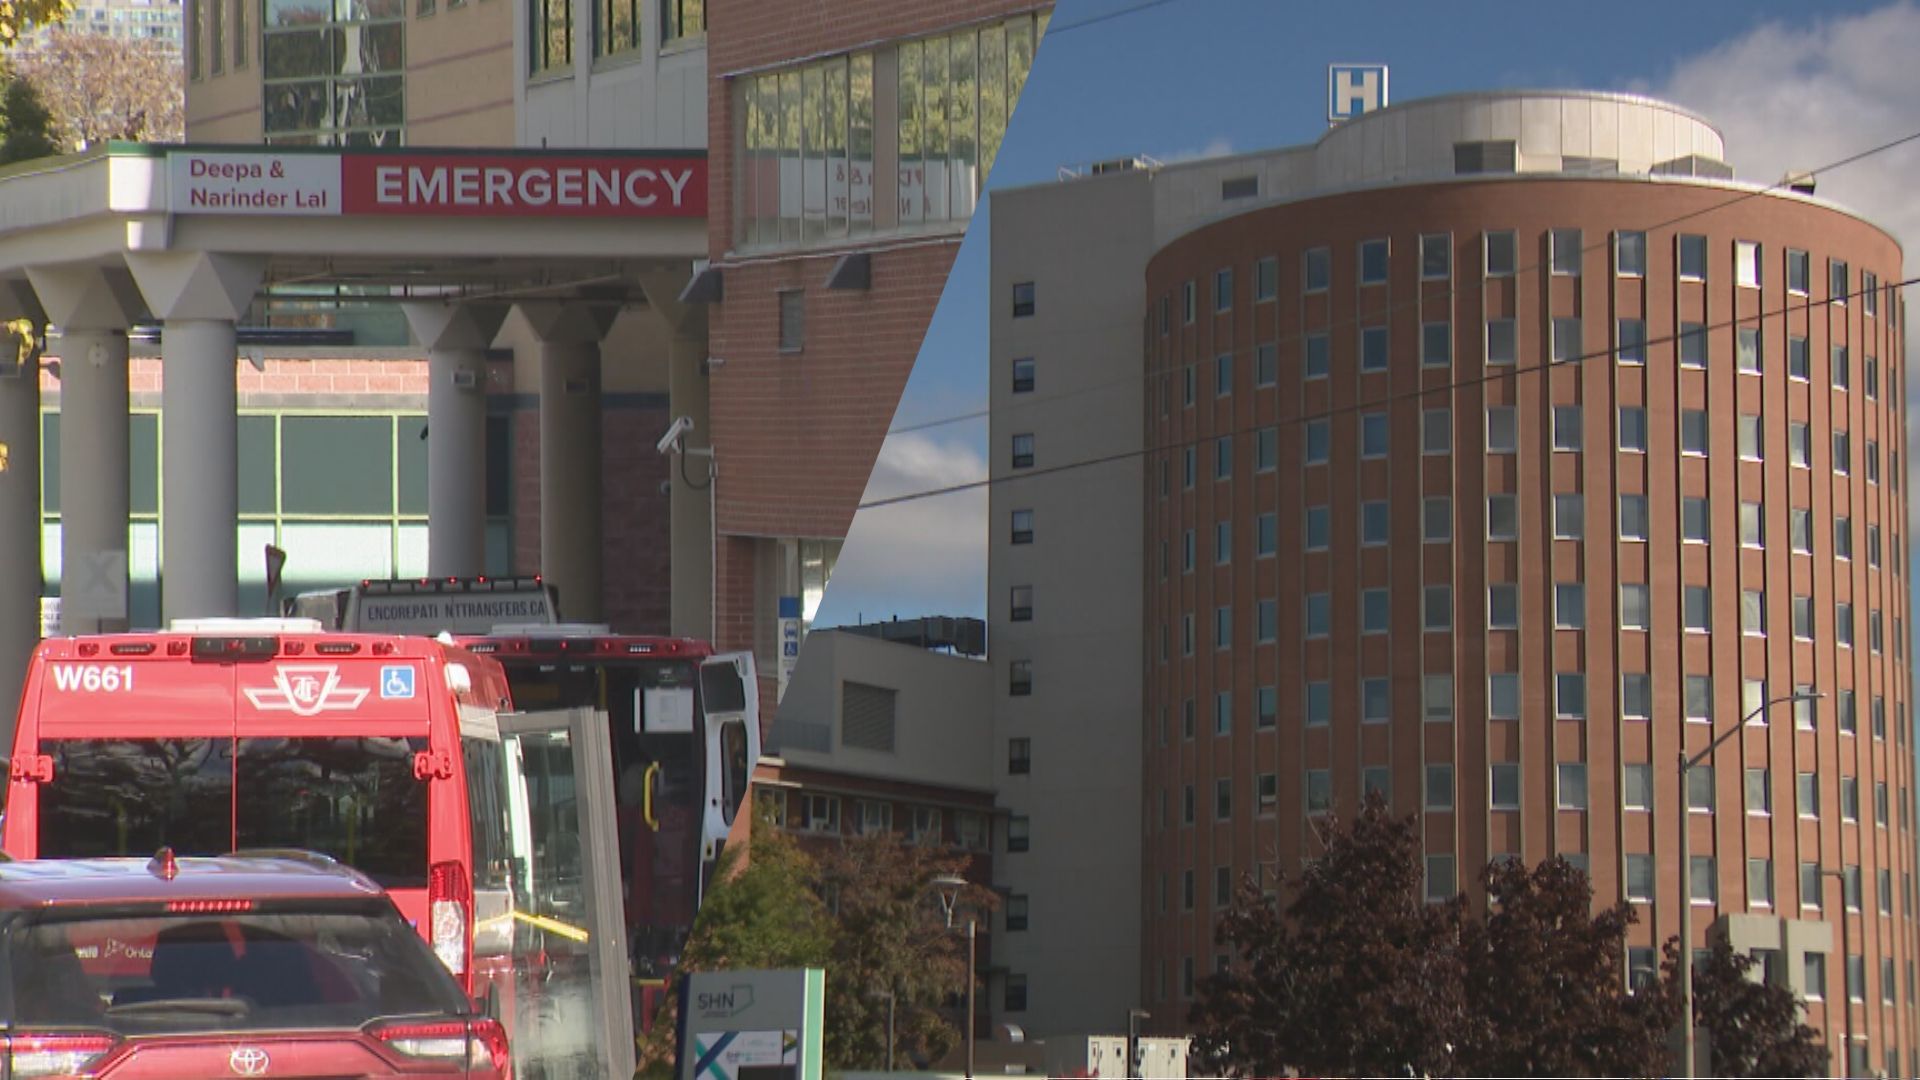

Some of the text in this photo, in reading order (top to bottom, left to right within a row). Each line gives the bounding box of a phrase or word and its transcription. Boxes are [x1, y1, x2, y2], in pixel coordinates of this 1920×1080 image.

[1337, 71, 1378, 114] H
[190, 158, 284, 182] Deepa &
[190, 188, 327, 208] Narinder Lal
[376, 166, 693, 207] EMERGENCY
[53, 665, 133, 691] W661
[698, 992, 734, 1010] SHN
